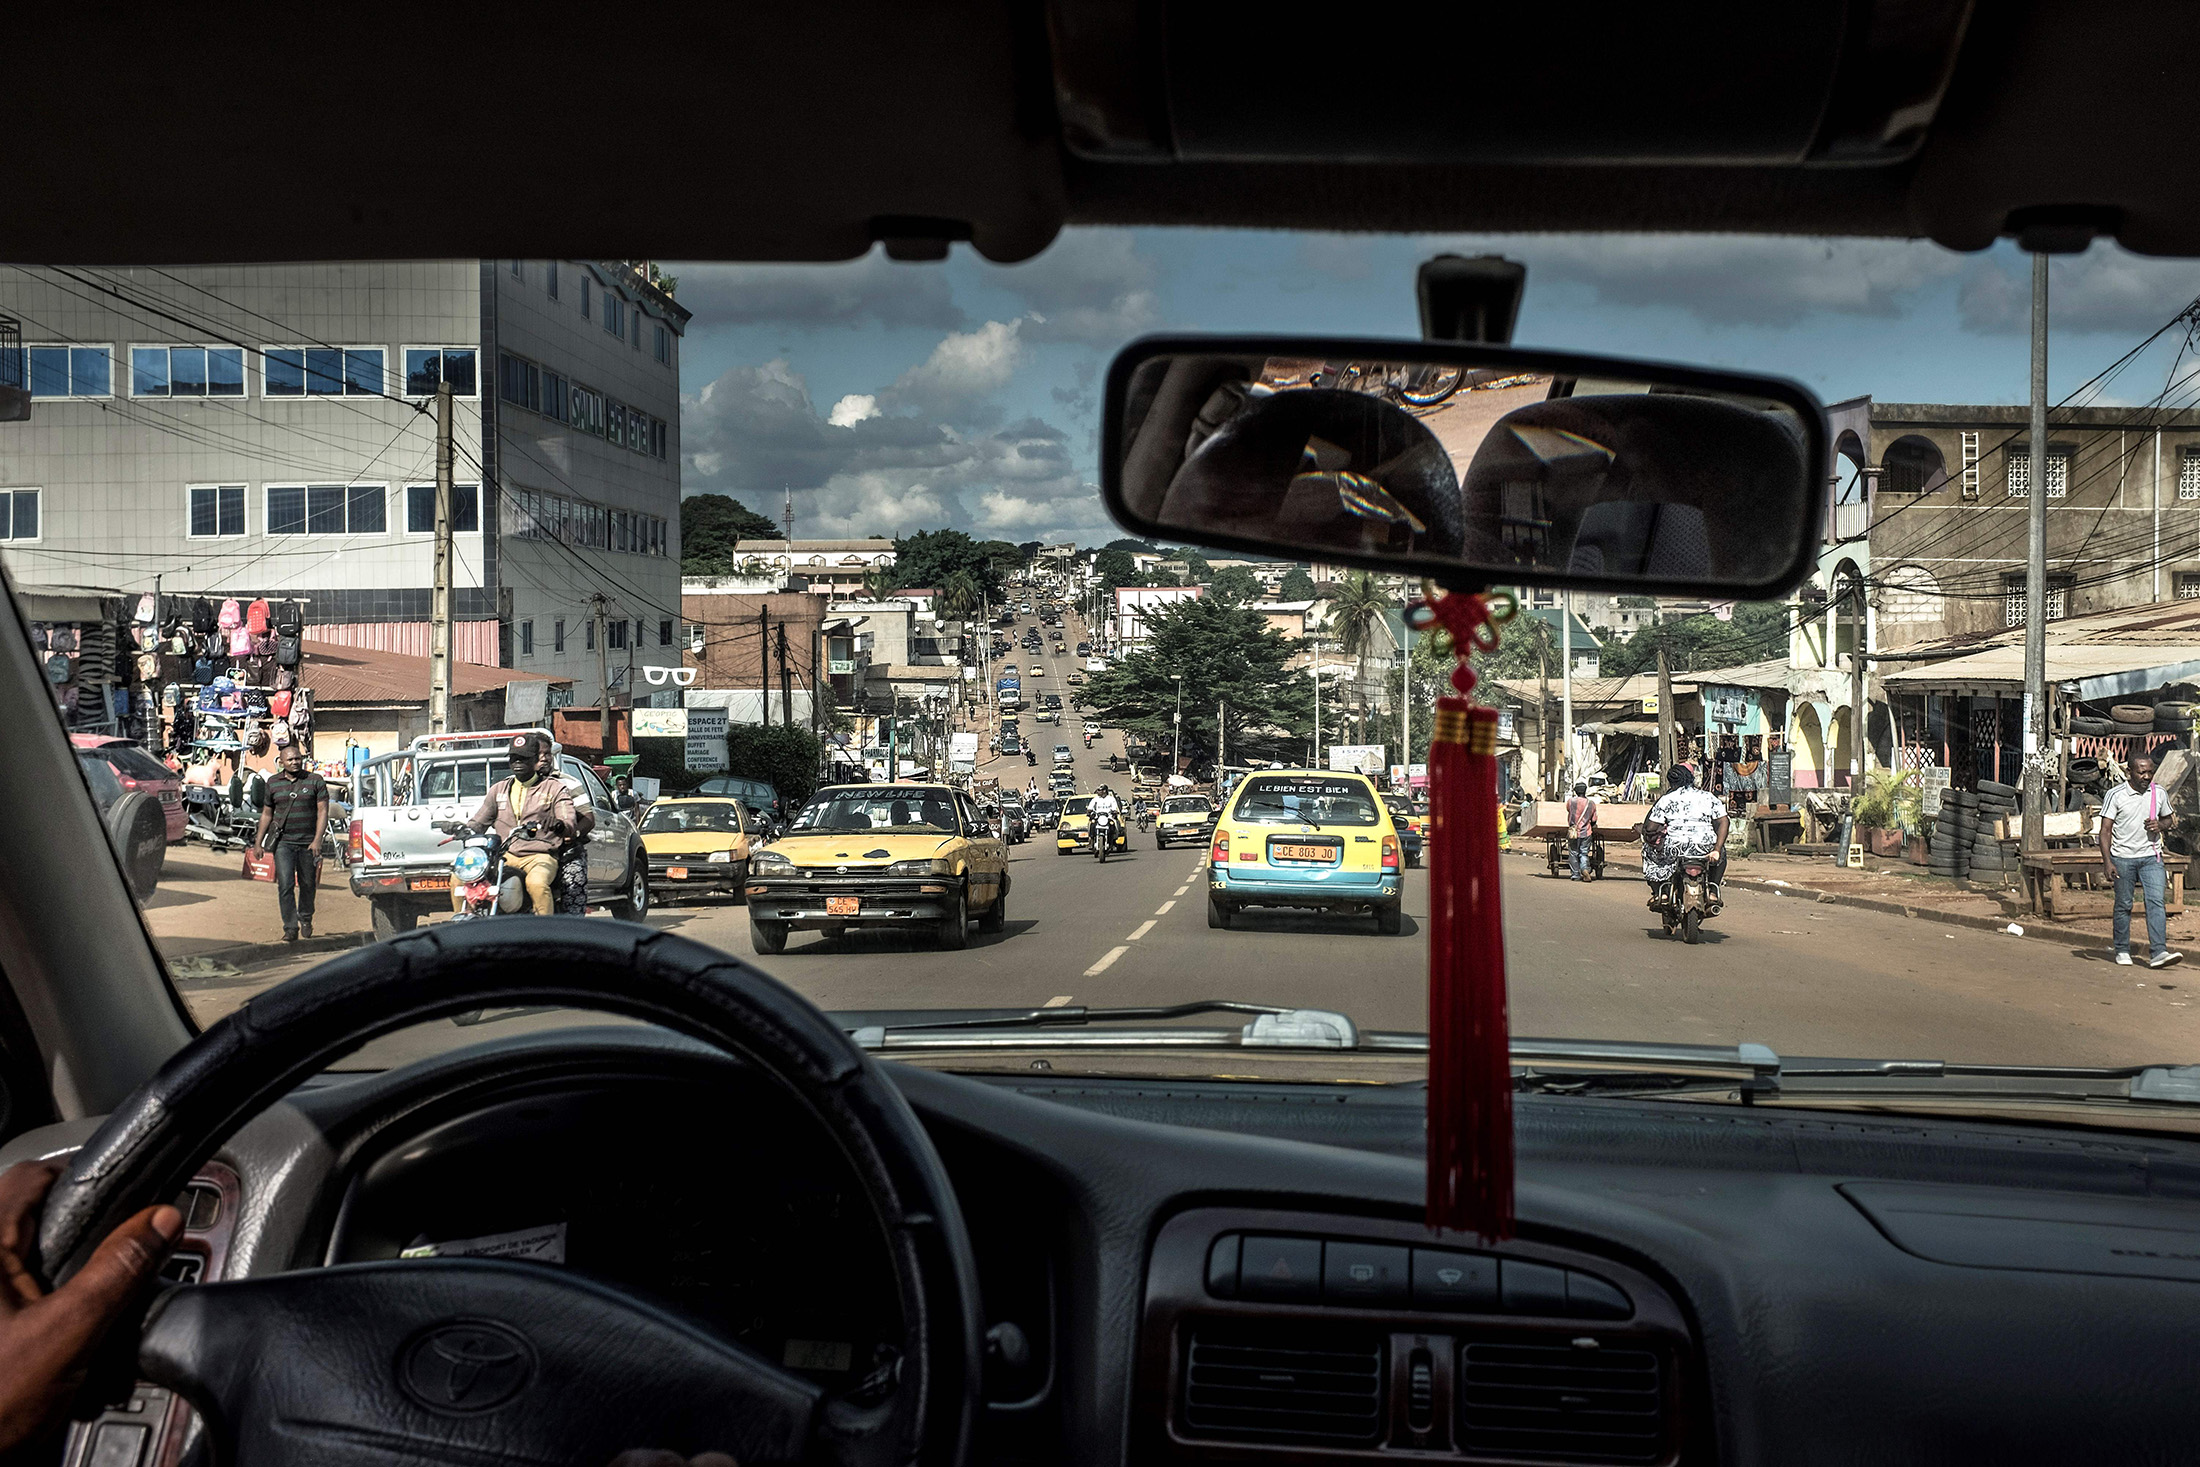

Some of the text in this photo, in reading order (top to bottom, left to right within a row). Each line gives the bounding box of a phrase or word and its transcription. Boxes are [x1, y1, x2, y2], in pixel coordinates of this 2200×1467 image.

[688, 717, 727, 725] ESPACE 2T
[864, 748, 889, 758] PHARMACIE
[1273, 785, 1296, 793] BIEN
[1325, 786, 1349, 794] BIEN
[835, 790, 925, 800] NEW LIFE
[388, 805, 475, 822] TOYOT
[1282, 846, 1294, 857] CE
[1298, 847, 1316, 858] 803
[420, 879, 433, 888] CE
[837, 897, 848, 905] CE
